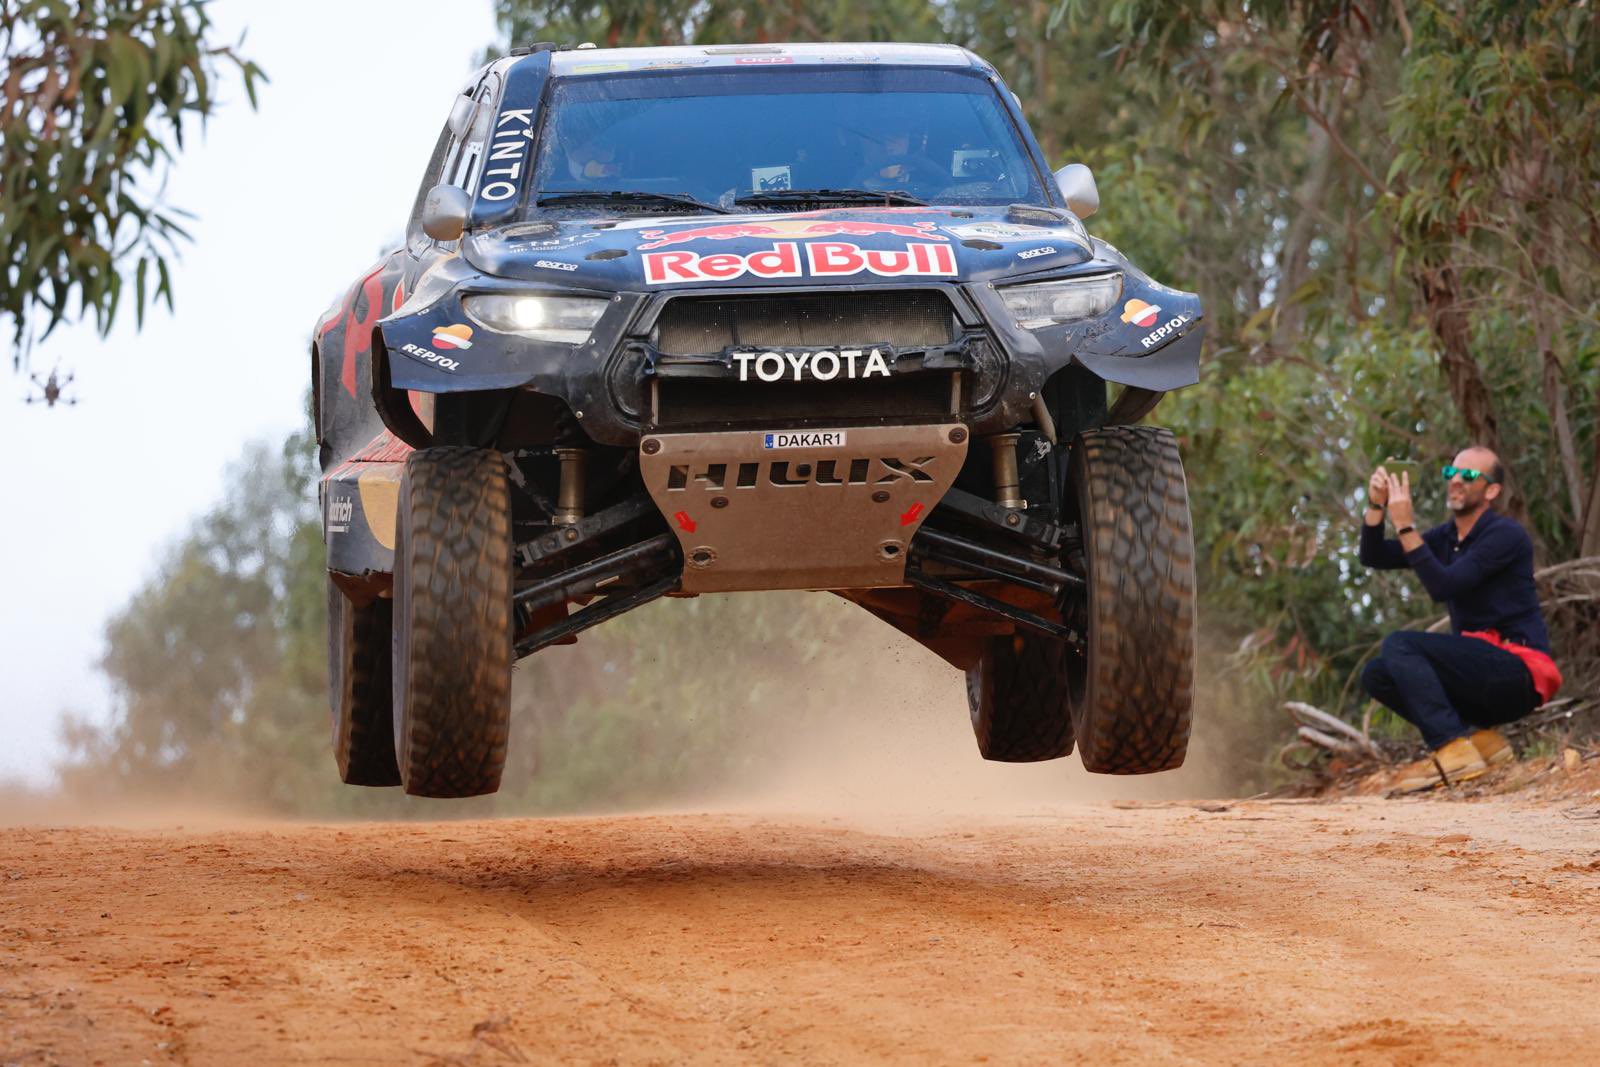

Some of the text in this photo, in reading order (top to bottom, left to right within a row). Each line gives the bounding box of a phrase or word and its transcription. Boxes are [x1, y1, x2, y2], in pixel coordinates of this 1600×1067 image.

[534, 260, 578, 271] sparco
[644, 242, 956, 282] Red Bull
[1017, 246, 1057, 260] sparco
[1141, 314, 1190, 349] REPSOL
[401, 343, 460, 371] REPSOL
[733, 349, 891, 382] TOYOTA
[778, 433, 840, 447] DAKAR1
[667, 456, 937, 492] HILUX
